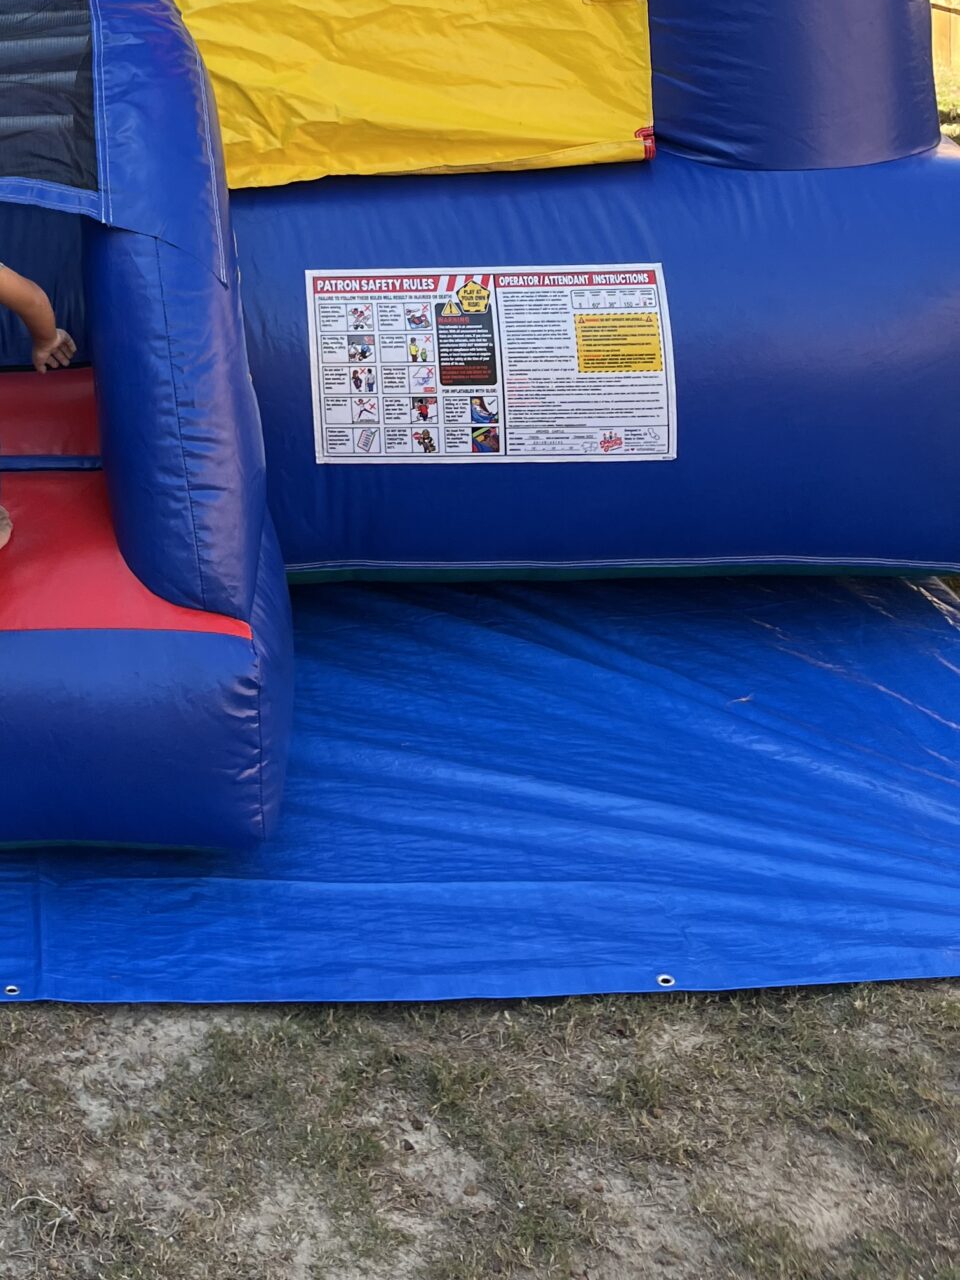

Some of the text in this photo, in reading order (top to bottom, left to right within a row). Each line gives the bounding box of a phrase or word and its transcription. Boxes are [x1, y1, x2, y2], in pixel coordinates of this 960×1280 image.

[316, 278, 435, 292] PATRON SAFETY RULES
[499, 275, 539, 286] OPERATOR
[544, 274, 589, 285] ATTENDANT
[592, 272, 649, 284] INSTRUCTIONS
[437, 316, 469, 325] WARNING
